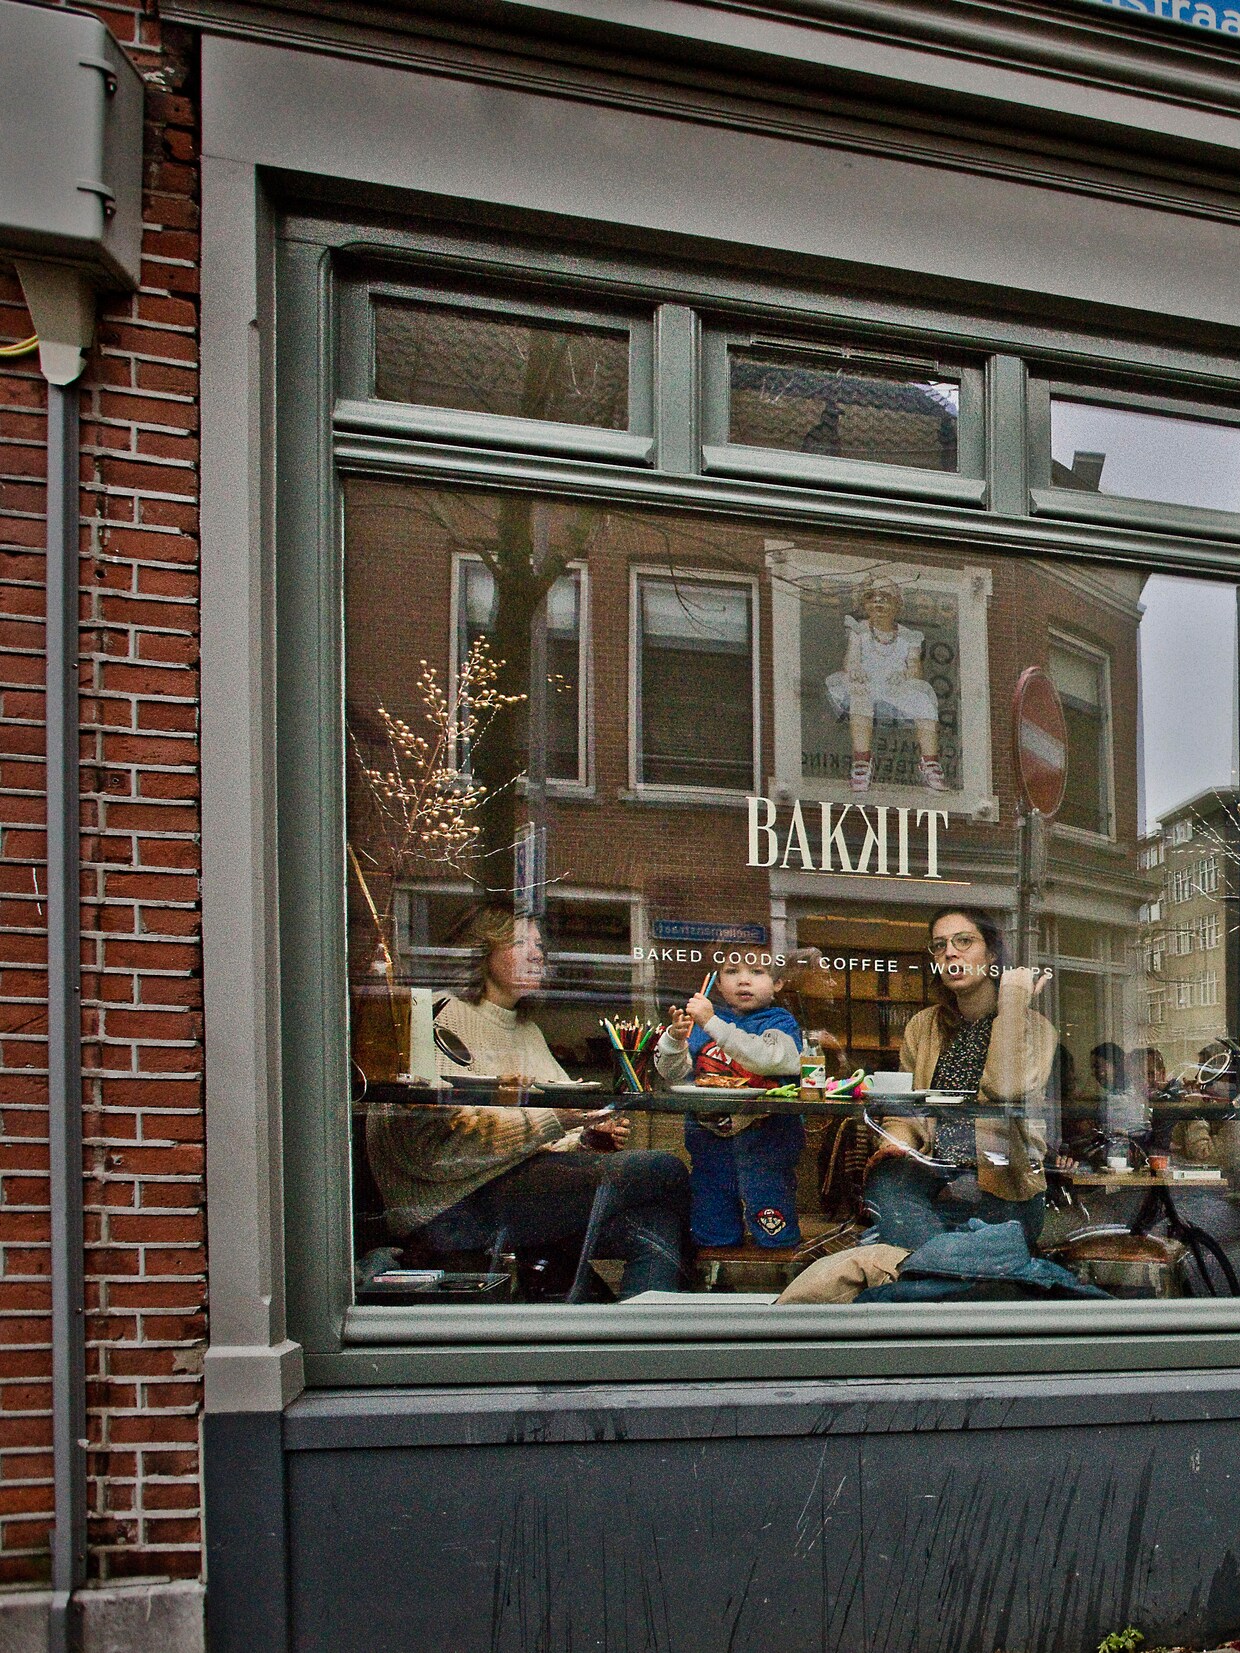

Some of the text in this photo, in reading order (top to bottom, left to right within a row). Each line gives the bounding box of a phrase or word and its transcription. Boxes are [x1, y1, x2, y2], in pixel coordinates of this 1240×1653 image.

[745, 796, 949, 878] BAKKIT
[633, 947, 702, 962] BAKED
[713, 951, 786, 966] GOODS
[819, 956, 898, 972] COFFEE
[930, 962, 1053, 980] WORKSPS
